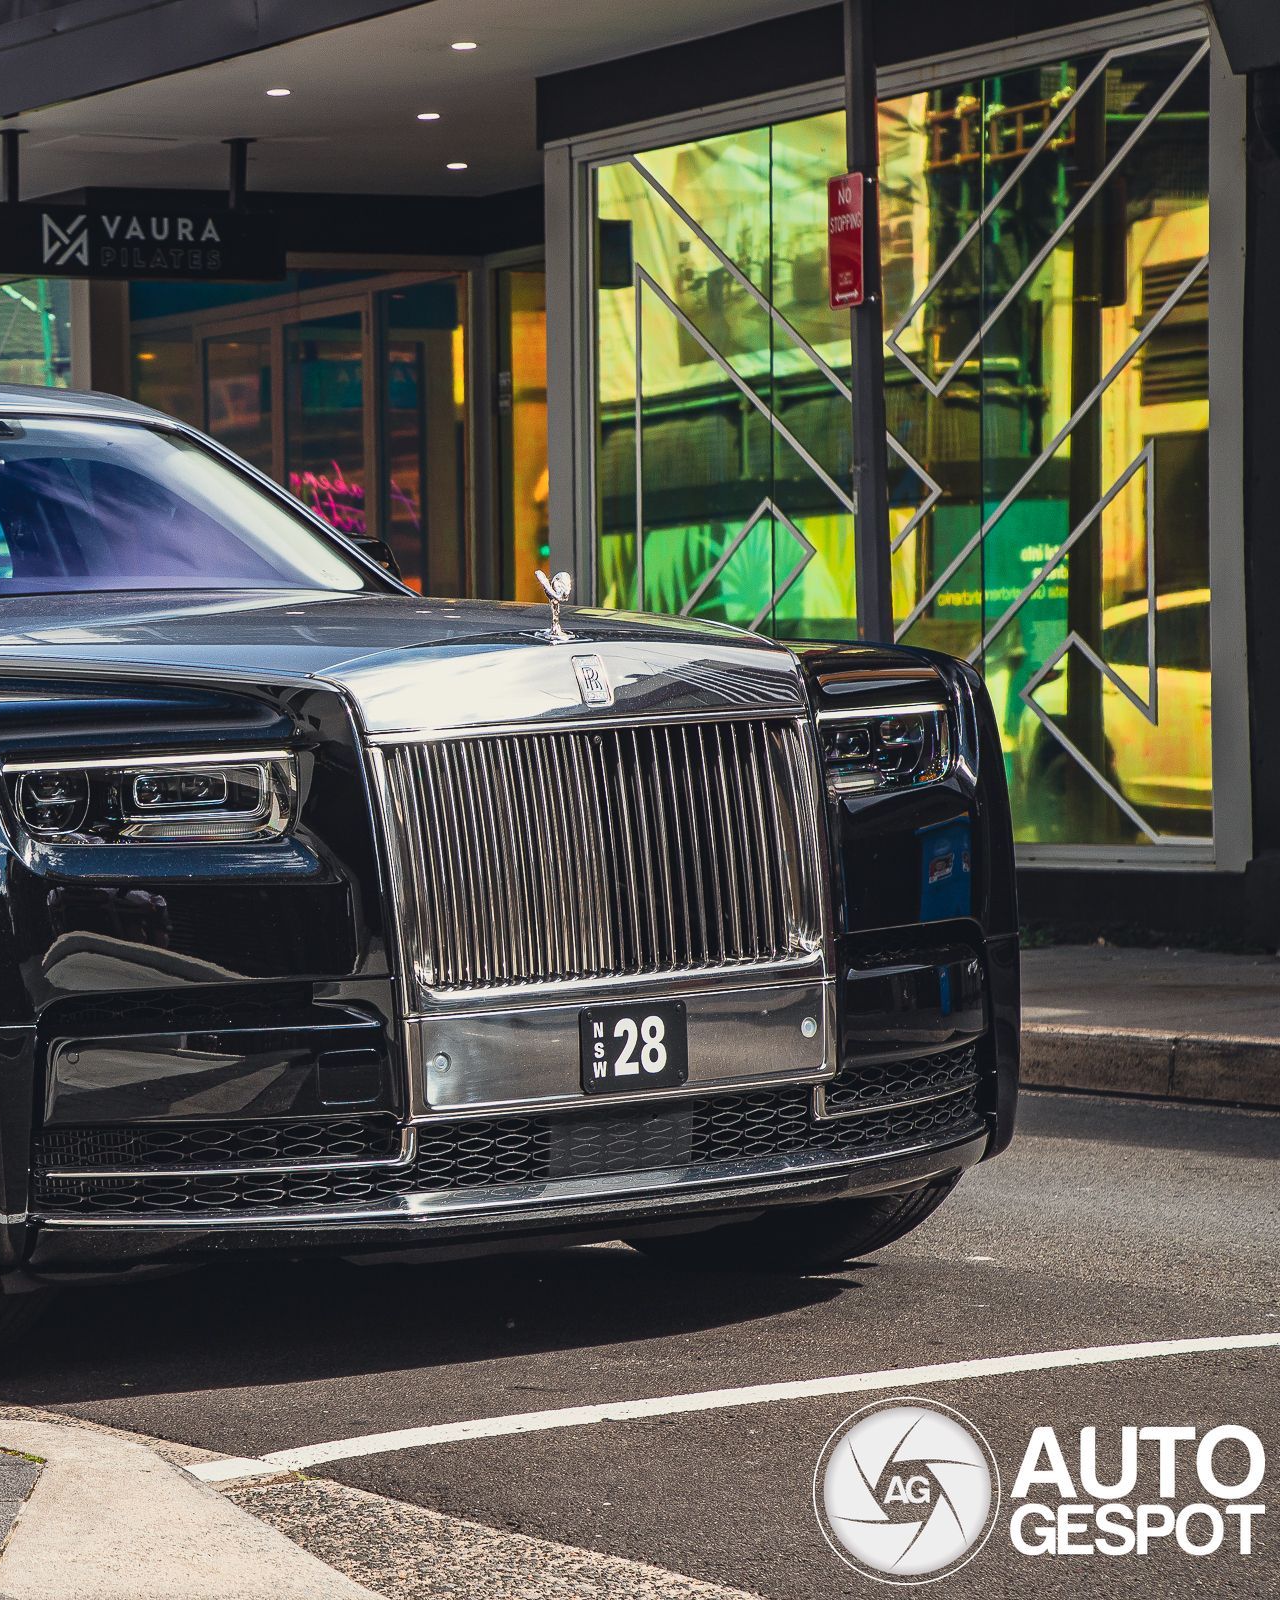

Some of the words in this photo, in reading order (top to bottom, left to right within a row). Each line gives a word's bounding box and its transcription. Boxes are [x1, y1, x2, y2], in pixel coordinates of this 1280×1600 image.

[837, 187, 852, 205] NO
[101, 215, 221, 242] VAURA
[829, 211, 861, 234] STOPPING
[101, 247, 221, 270] PILATES
[592, 1021, 608, 1078] NSW
[613, 1015, 668, 1076] 28
